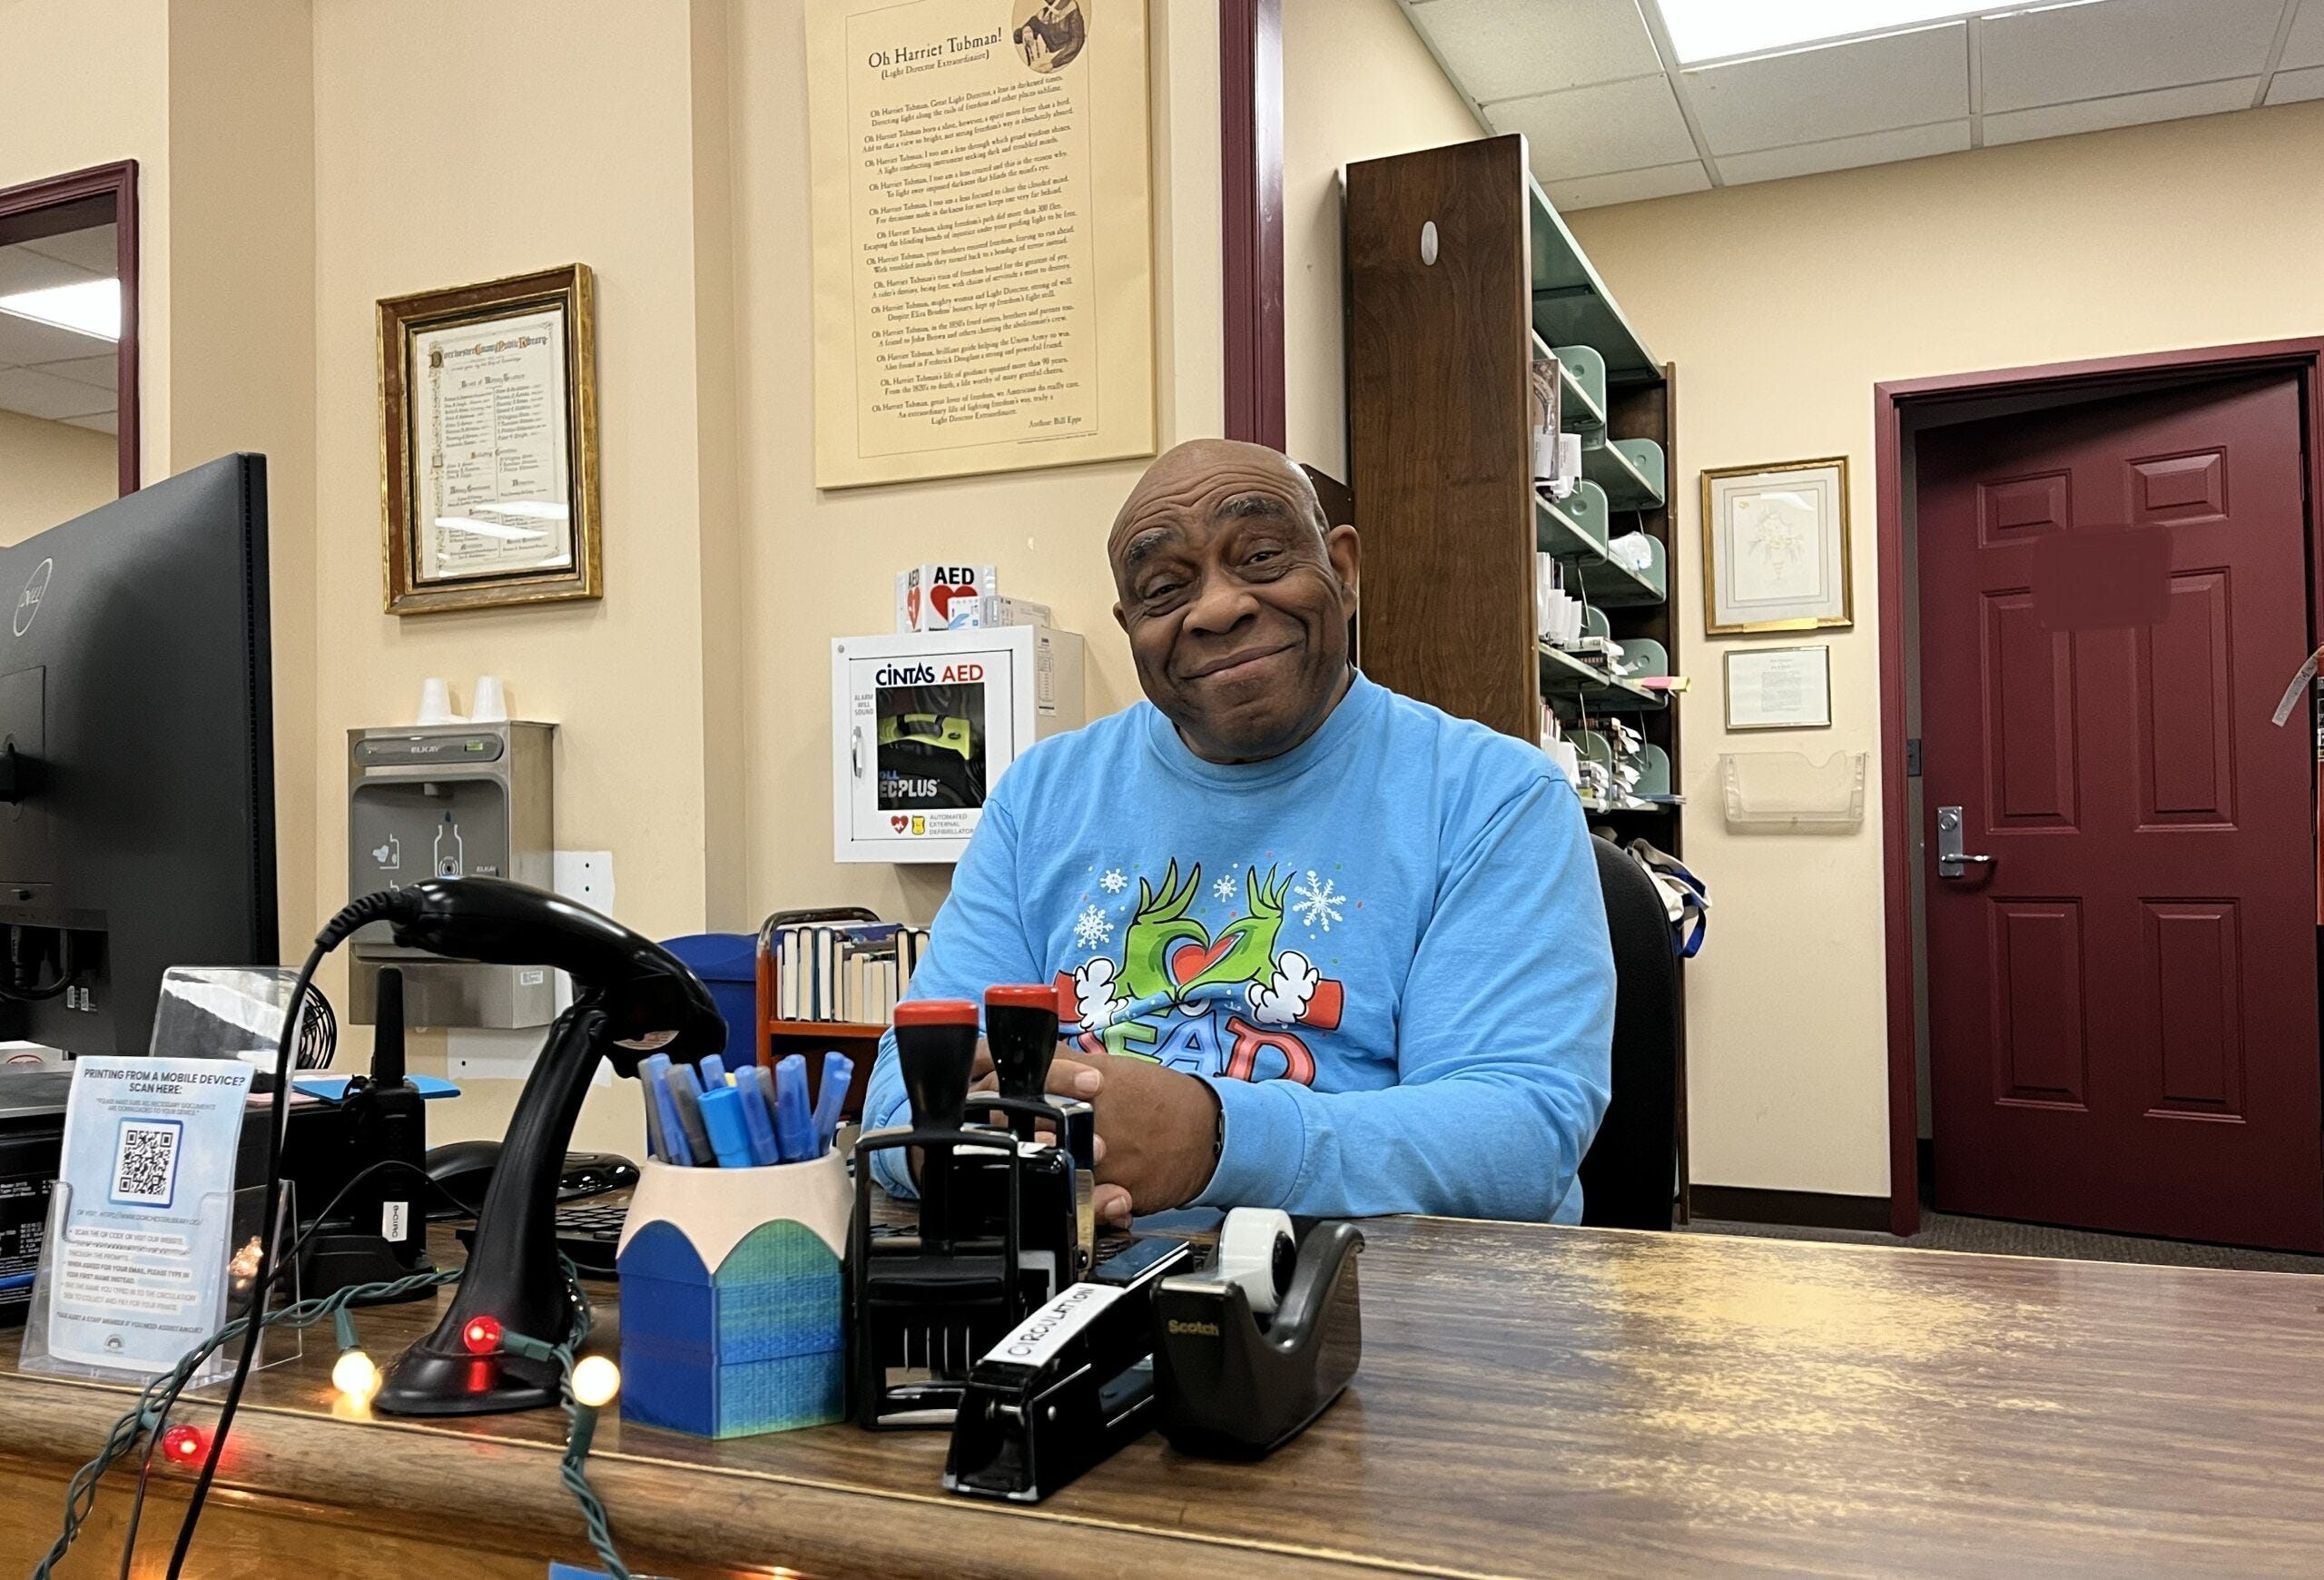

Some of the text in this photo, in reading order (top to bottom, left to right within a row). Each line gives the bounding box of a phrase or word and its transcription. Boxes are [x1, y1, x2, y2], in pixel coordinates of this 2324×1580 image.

[868, 26, 1002, 68] Oh Harriet Tubman!
[881, 67, 904, 81] (Light
[905, 62, 935, 75] Director
[948, 95, 964, 104] Light
[931, 416, 947, 425] Light
[1067, 416, 1081, 424] Epps
[908, 568, 920, 588] AED
[933, 567, 975, 585] AED
[941, 664, 983, 683] AED
[410, 746, 439, 754] ELKAY
[879, 770, 900, 780] OLL
[1069, 1009, 1315, 1087] EAD
[84, 1069, 245, 1087] PRINTING FROM A MOBILE DEVICE?
[129, 1082, 182, 1094] SCAN HERE:
[1008, 1286, 1095, 1358] CIRCULATION
[1167, 1319, 1220, 1337] Scotch
